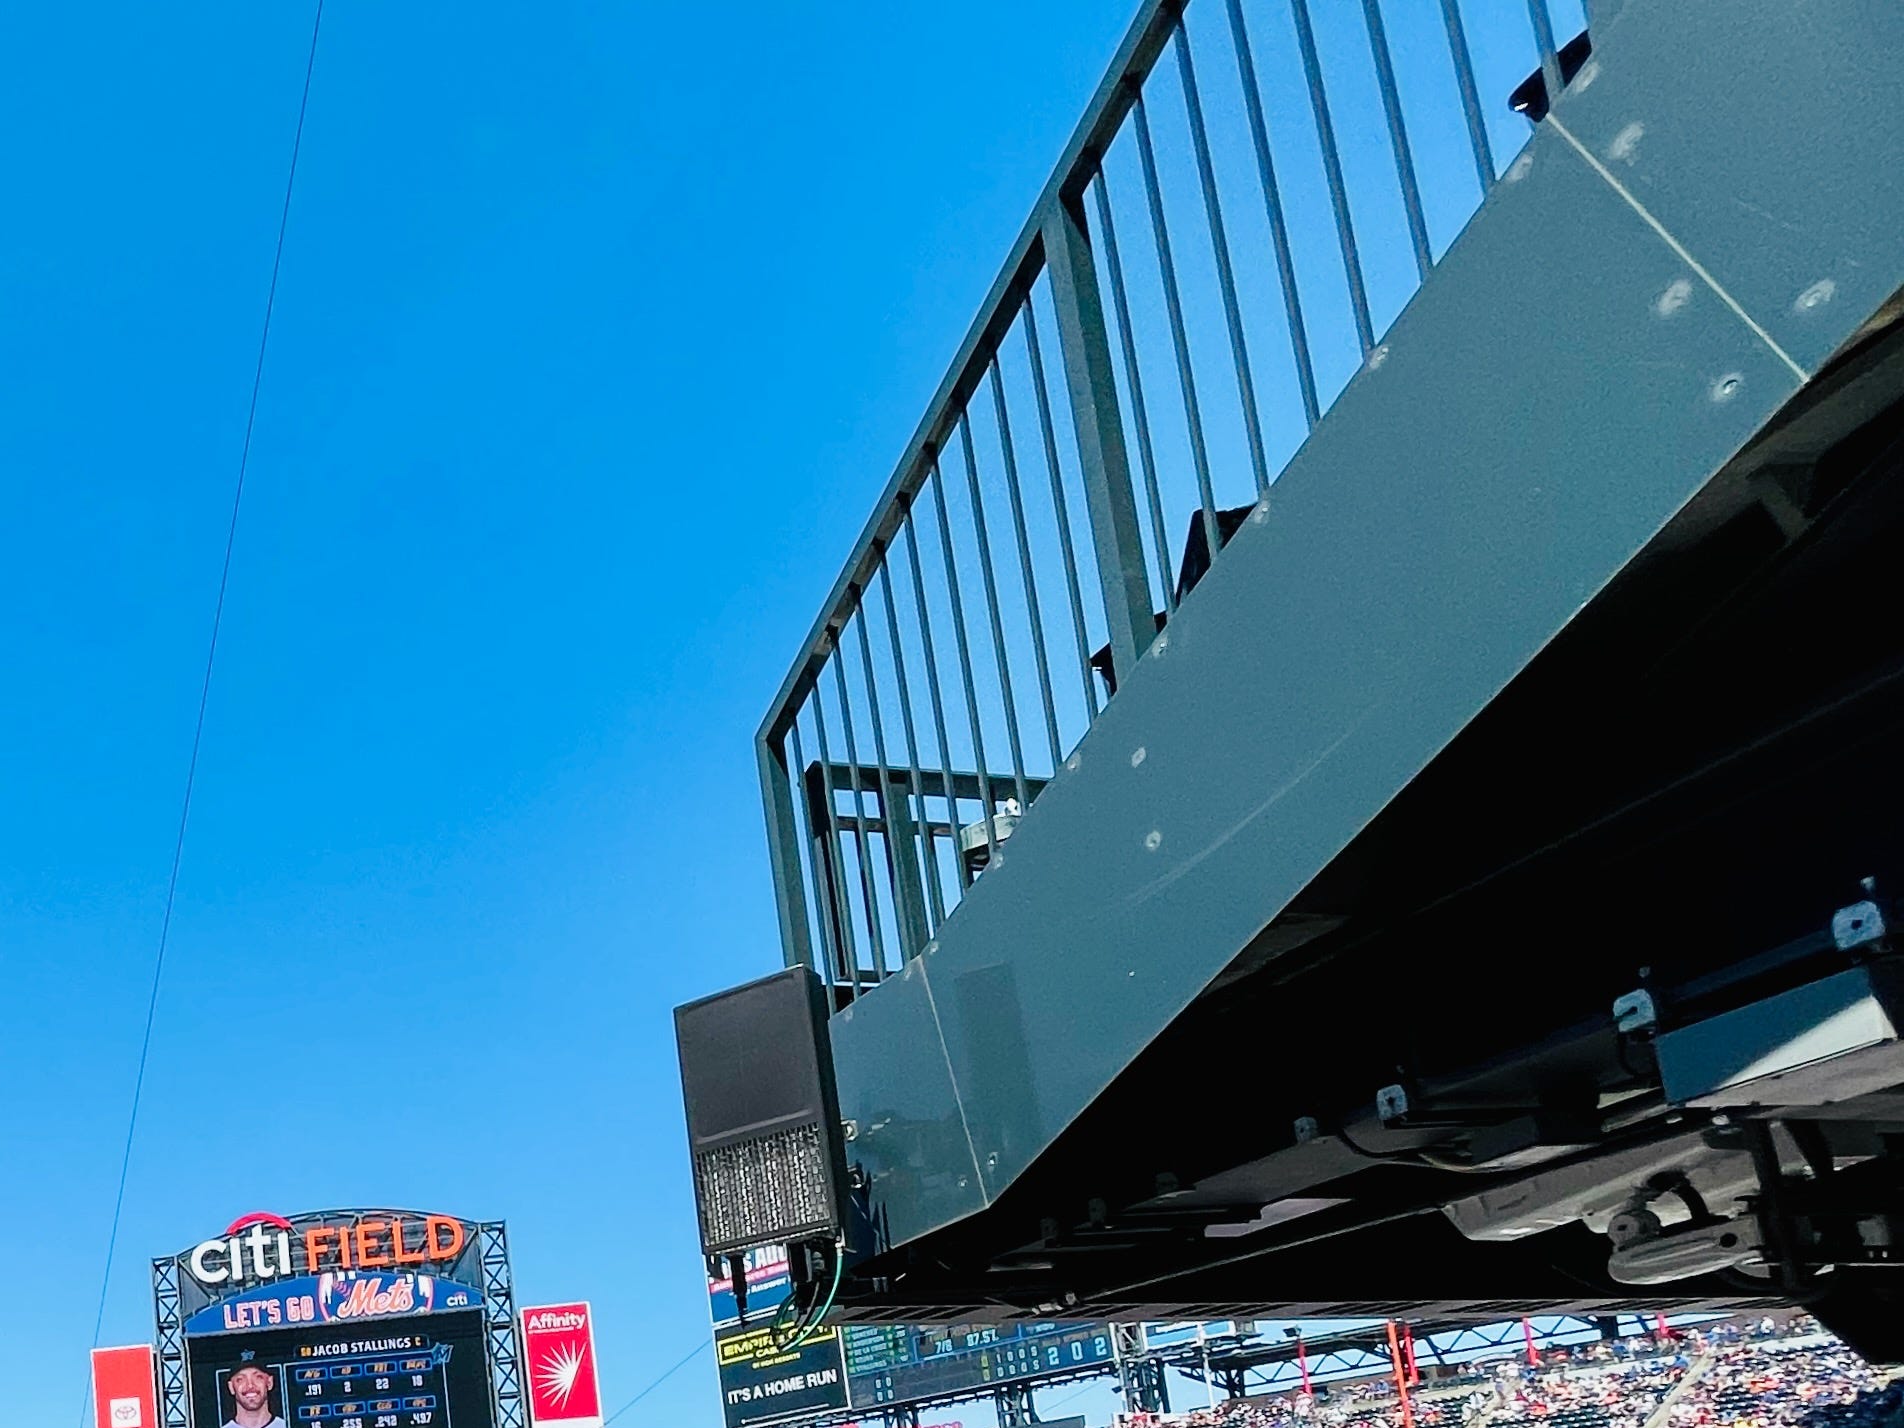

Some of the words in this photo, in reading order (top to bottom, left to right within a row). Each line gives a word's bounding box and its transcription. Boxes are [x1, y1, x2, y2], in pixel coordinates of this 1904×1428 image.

[190, 1222, 293, 1283] citi
[306, 1216, 465, 1272] FIELD
[223, 1298, 281, 1330] LET'S
[286, 1295, 314, 1322] GO
[337, 1276, 414, 1319] Mets
[446, 1292, 468, 1307] citi
[528, 1313, 586, 1330] Affinity
[312, 1343, 349, 1357] JACOB
[350, 1337, 411, 1353] STALLINGS
[1048, 1347, 1059, 1366] 2
[1071, 1341, 1083, 1361] 0
[1095, 1337, 1107, 1356] 2
[727, 1388, 752, 1405] IT'S
[753, 1387, 764, 1400] A
[764, 1376, 806, 1397] HOME
[806, 1369, 838, 1388] RUN
